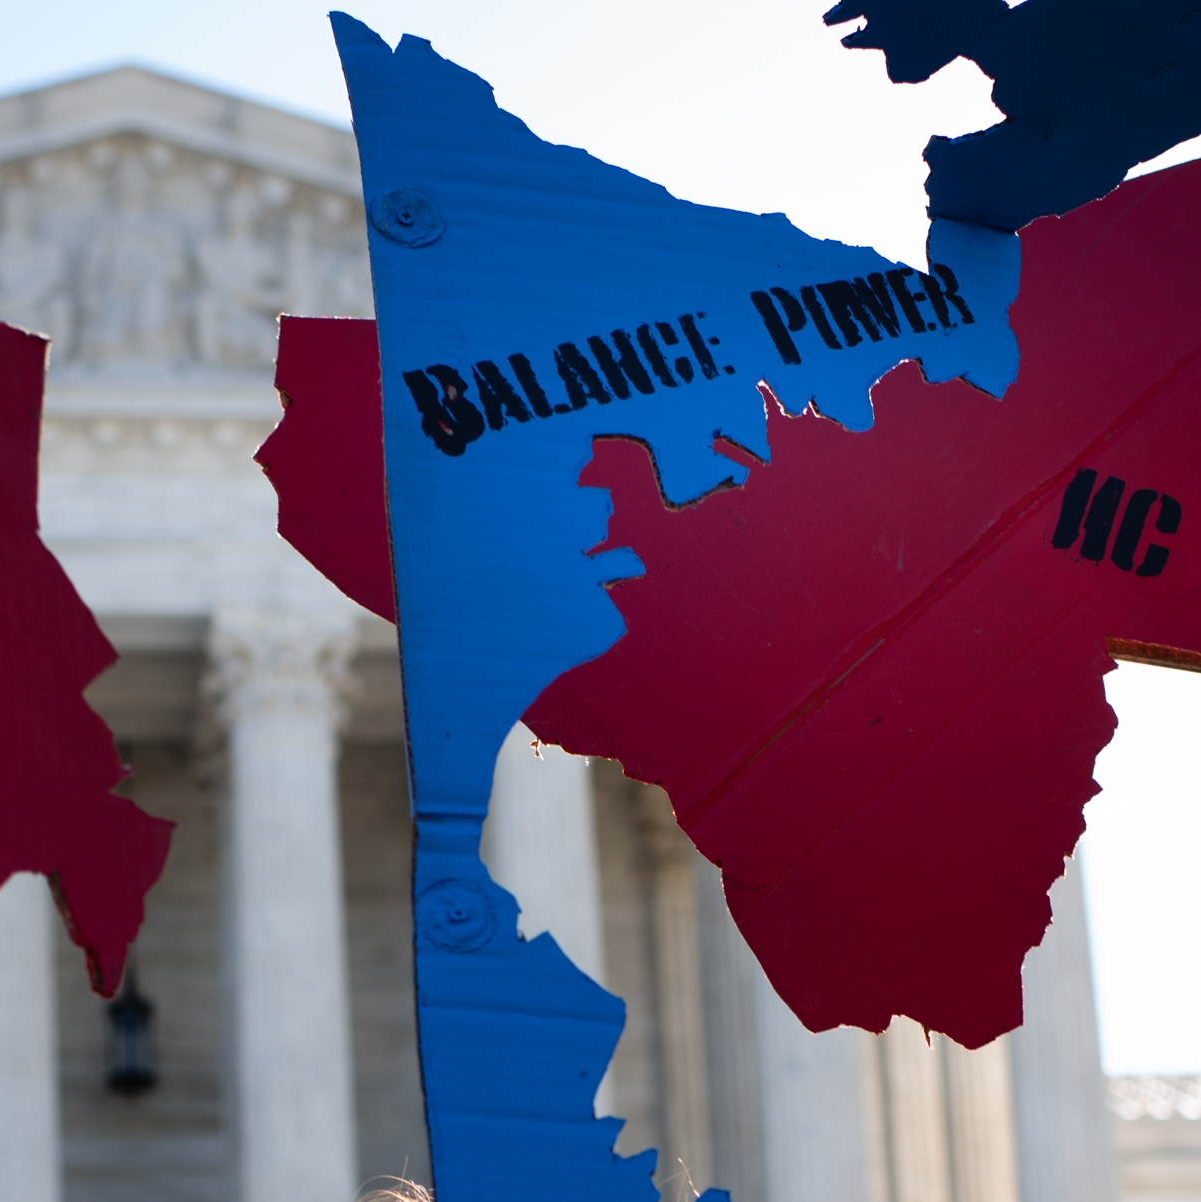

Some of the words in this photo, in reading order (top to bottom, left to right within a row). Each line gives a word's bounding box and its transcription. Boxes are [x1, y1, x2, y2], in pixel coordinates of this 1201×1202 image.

[402, 311, 735, 457] BALANCE
[750, 263, 975, 366] POWER
[1051, 467, 1182, 577] NC
